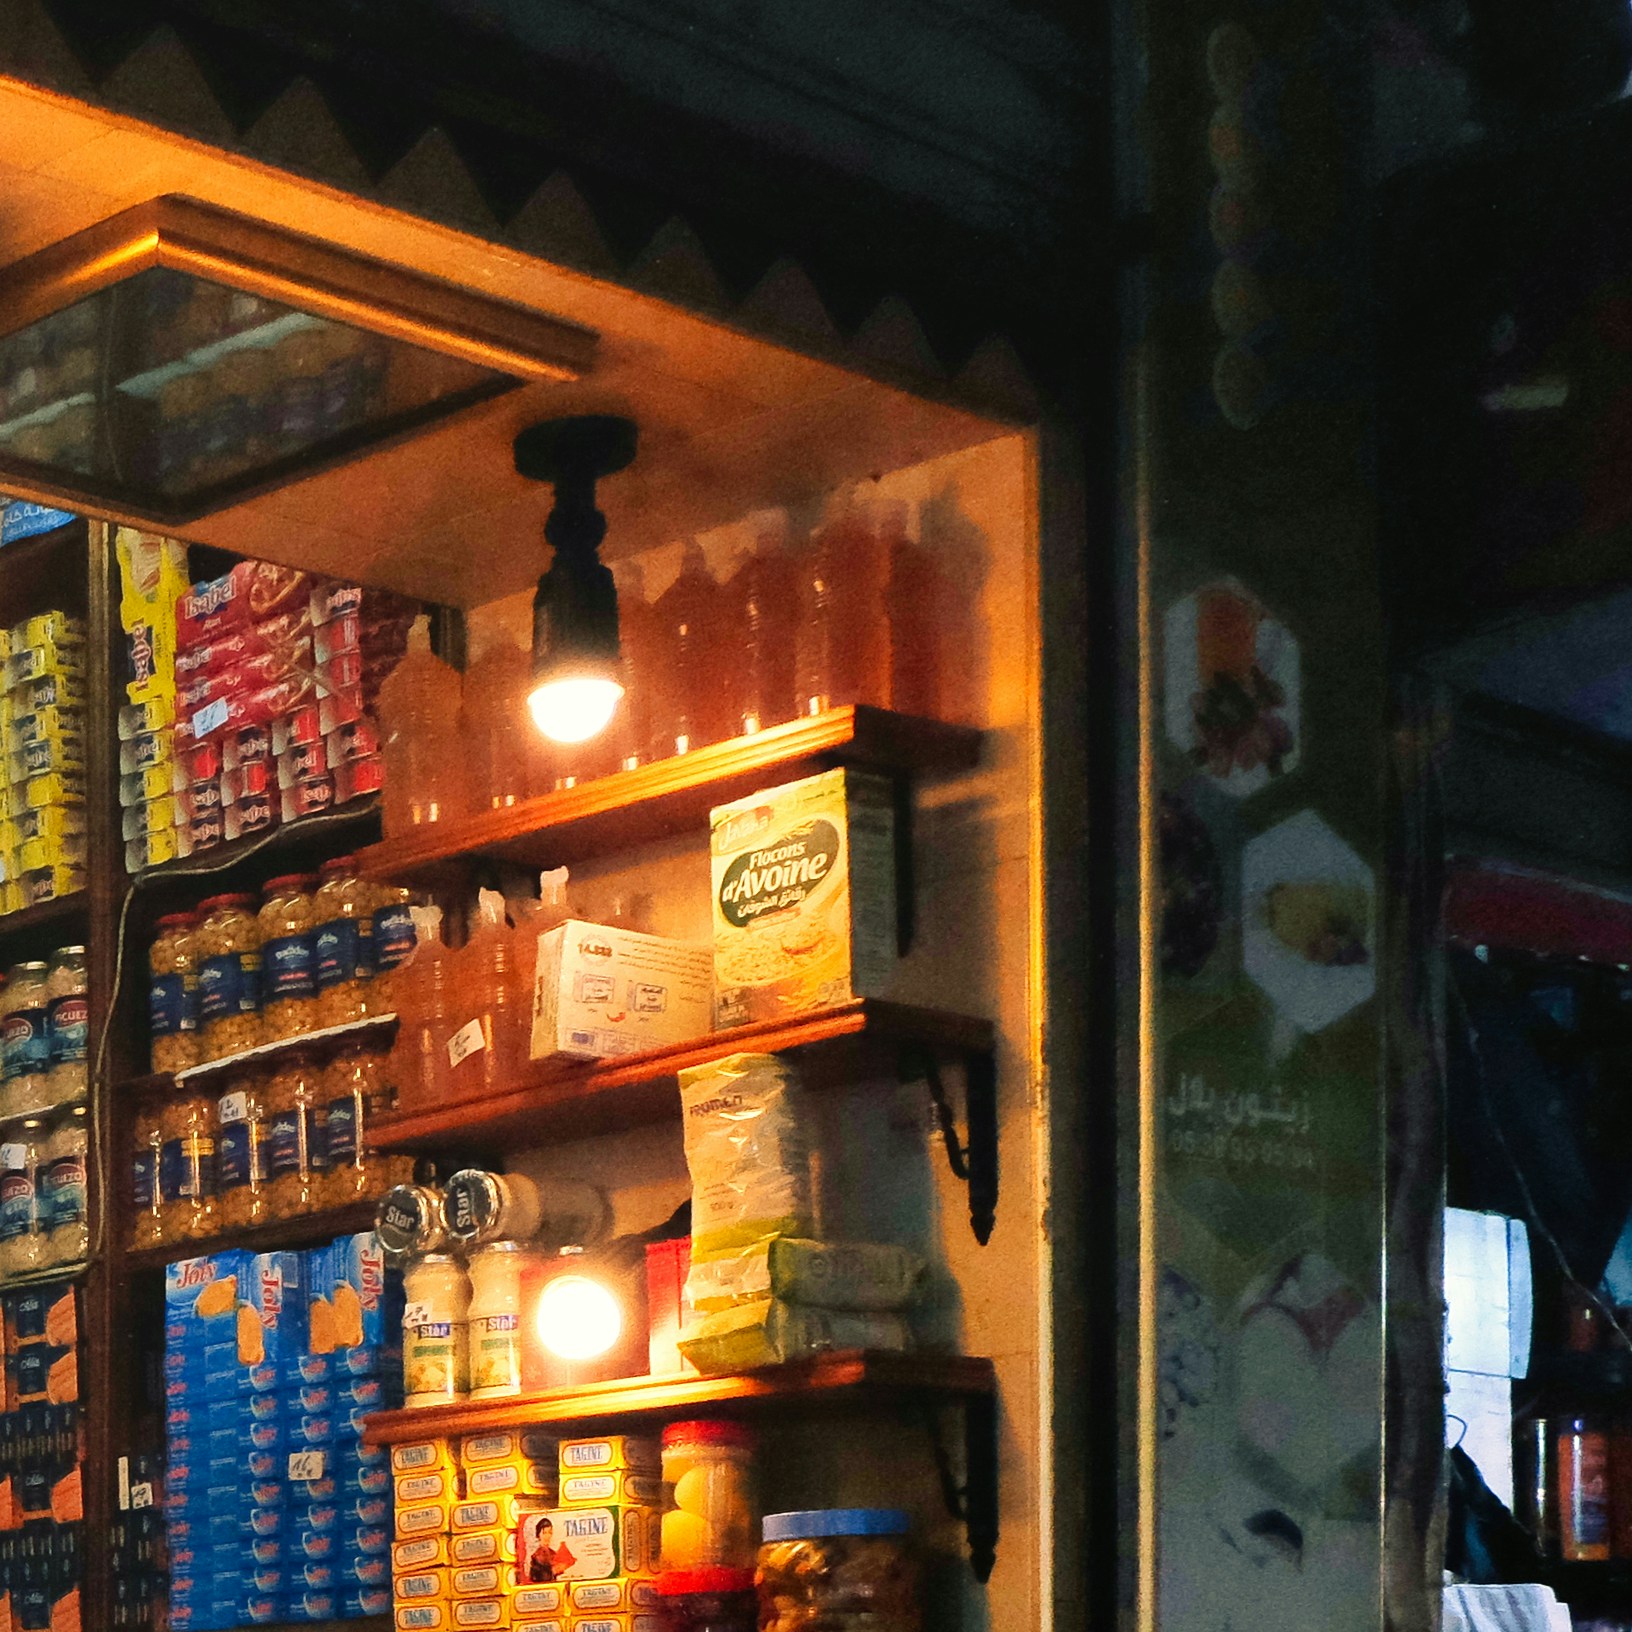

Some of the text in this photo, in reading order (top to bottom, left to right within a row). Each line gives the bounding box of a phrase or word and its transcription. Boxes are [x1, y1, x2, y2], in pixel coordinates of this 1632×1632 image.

[185, 575, 237, 620] Isabel
[749, 841, 807, 870] Flocons
[721, 852, 828, 904] d'Avoine
[385, 1205, 415, 1231] Star
[455, 1188, 471, 1229] Star
[419, 1323, 449, 1338] Star
[564, 1515, 609, 1537] TAGINE
